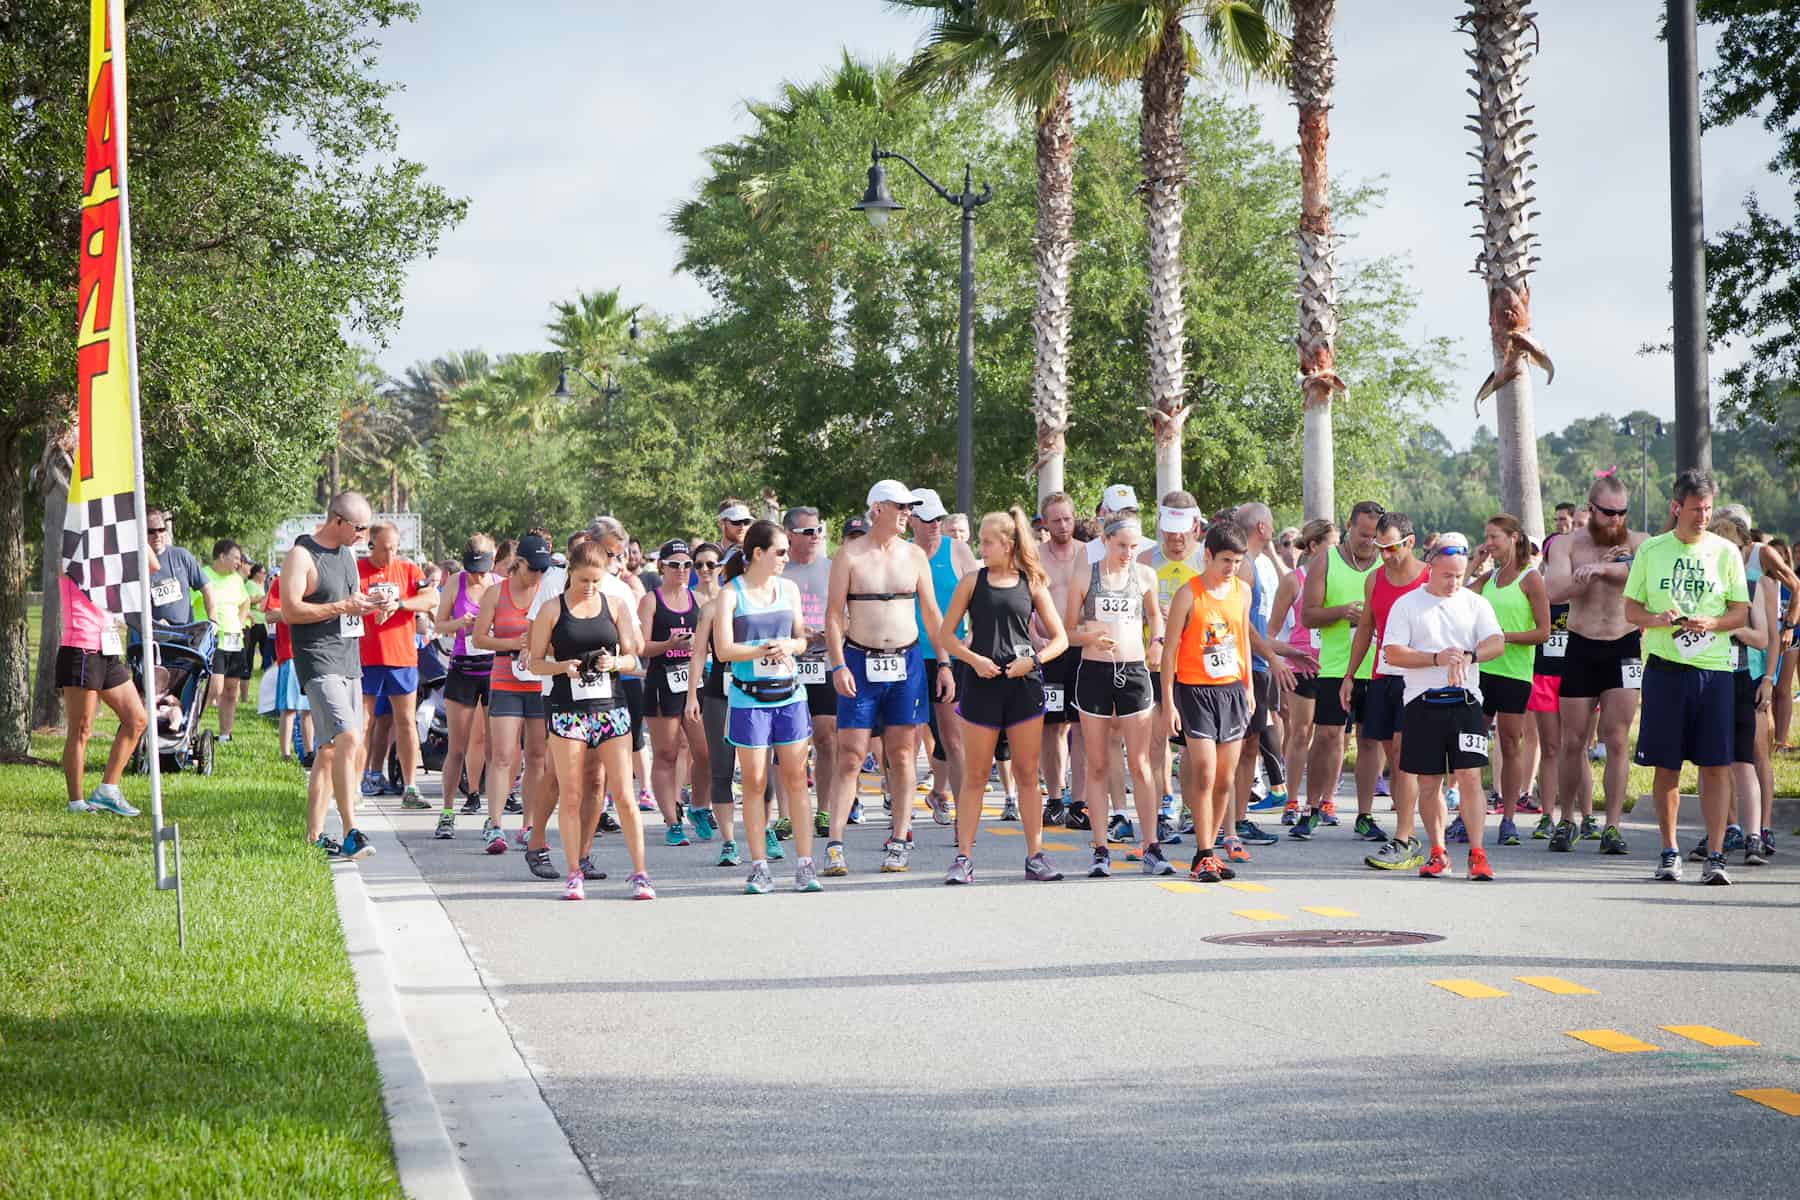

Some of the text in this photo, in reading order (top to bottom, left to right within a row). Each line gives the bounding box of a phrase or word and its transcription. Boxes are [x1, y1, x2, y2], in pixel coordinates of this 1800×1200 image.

[1674, 558, 1704, 571] ALL
[1660, 578, 1716, 592] EVERY
[1103, 598, 1129, 612] 332
[797, 663, 819, 674] 308
[873, 659, 897, 671] 319
[673, 670, 688, 683] 30
